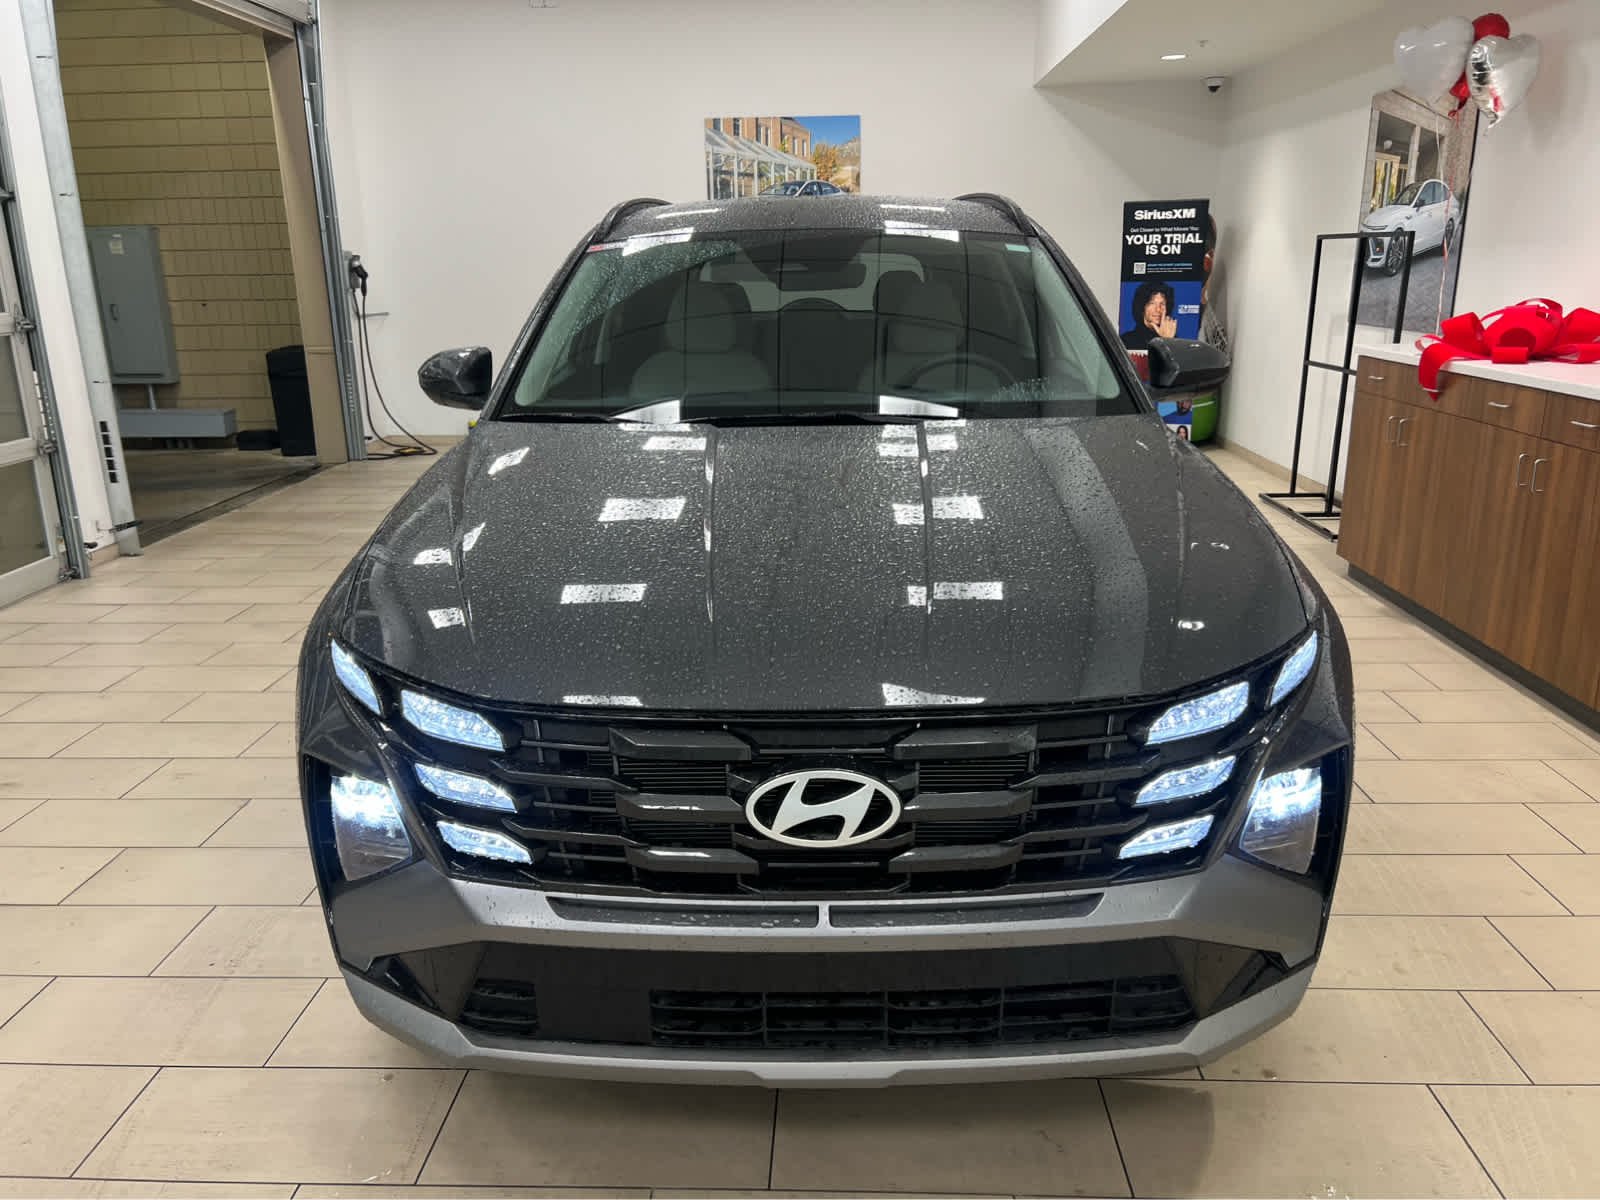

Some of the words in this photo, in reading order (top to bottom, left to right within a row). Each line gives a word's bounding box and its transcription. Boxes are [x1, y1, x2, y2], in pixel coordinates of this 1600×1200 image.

[1134, 208, 1196, 220] SiriusXM
[1125, 234, 1162, 245] YOUR
[1164, 233, 1204, 244] TRIAL
[1145, 245, 1159, 255] IS
[1160, 244, 1181, 255] ON
